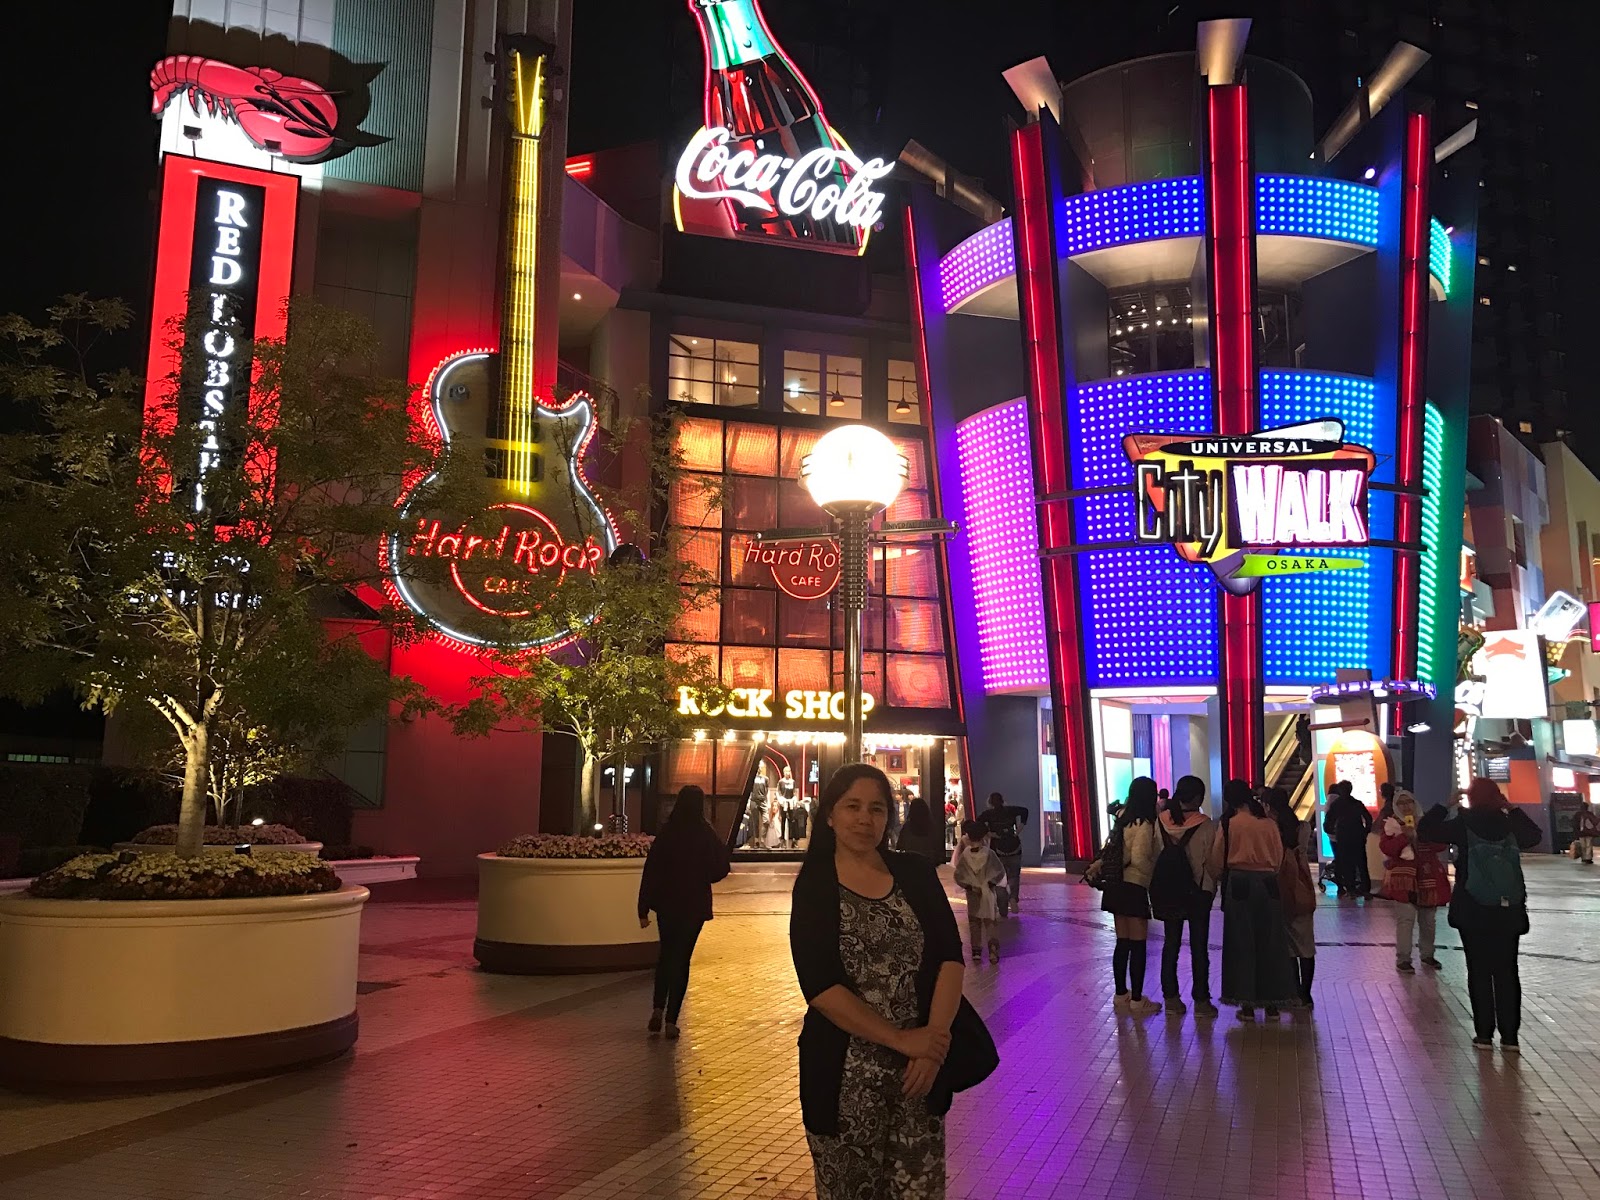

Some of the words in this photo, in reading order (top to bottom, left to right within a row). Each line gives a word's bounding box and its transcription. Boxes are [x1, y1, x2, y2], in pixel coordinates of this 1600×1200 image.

[675, 127, 896, 227] Coca-Cola
[209, 189, 248, 285] RED
[1190, 440, 1314, 454] UNIVERSAL
[1136, 461, 1223, 557] City
[1233, 464, 1368, 544] WALK
[408, 518, 511, 561] Hard
[514, 534, 604, 575] Rock
[745, 539, 804, 565] Hard
[808, 543, 838, 572] Ro
[790, 575, 822, 587] CAFE
[1266, 558, 1329, 570] OSAKA
[676, 684, 773, 718] ROCK
